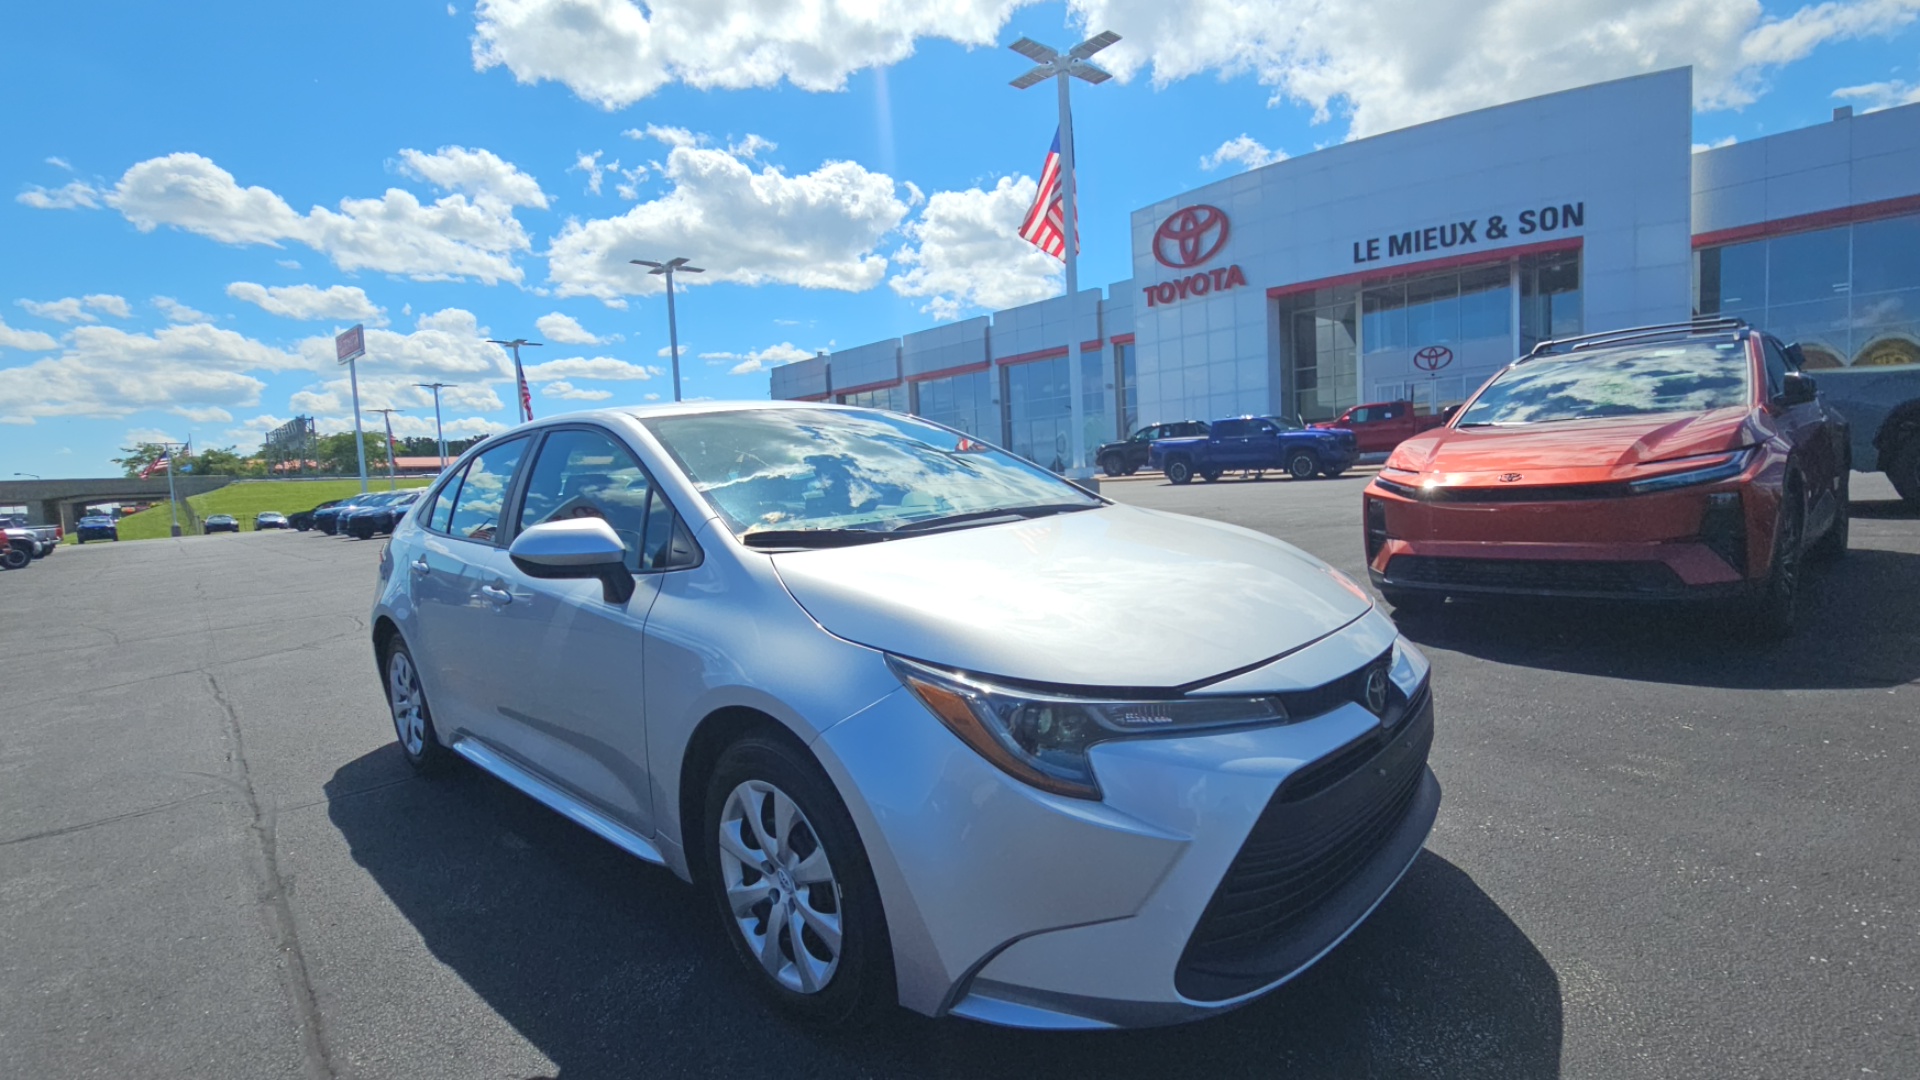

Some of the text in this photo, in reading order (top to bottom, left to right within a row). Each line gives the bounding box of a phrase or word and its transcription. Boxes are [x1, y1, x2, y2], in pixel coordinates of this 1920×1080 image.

[1353, 202, 1584, 264] LE MIEUX & SON
[1143, 264, 1248, 308] TOYOTA
